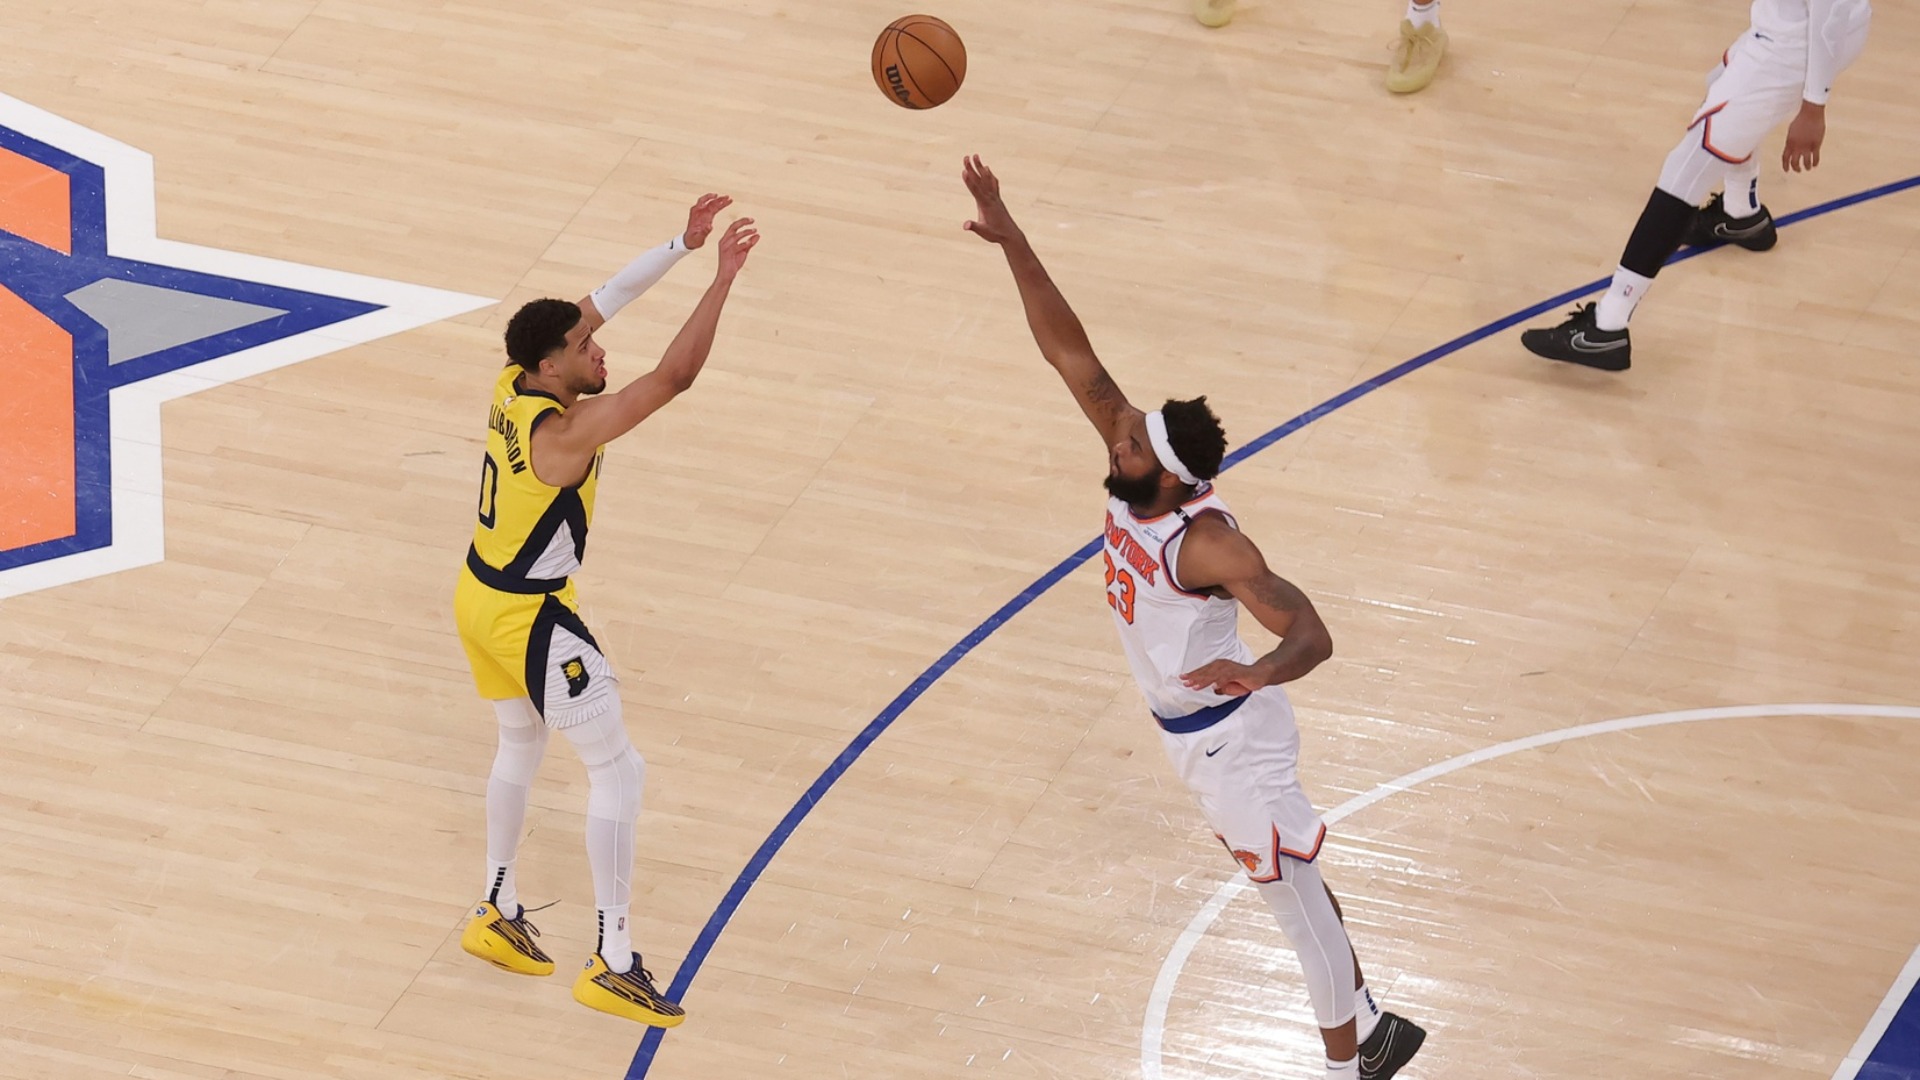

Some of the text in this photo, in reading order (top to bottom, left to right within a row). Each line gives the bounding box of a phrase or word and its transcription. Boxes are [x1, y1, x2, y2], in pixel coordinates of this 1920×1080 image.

[489, 403, 527, 475] LLIBURTON
[479, 450, 499, 530] 0
[1104, 549, 1136, 625] 23
[1119, 529, 1159, 587] YORK
